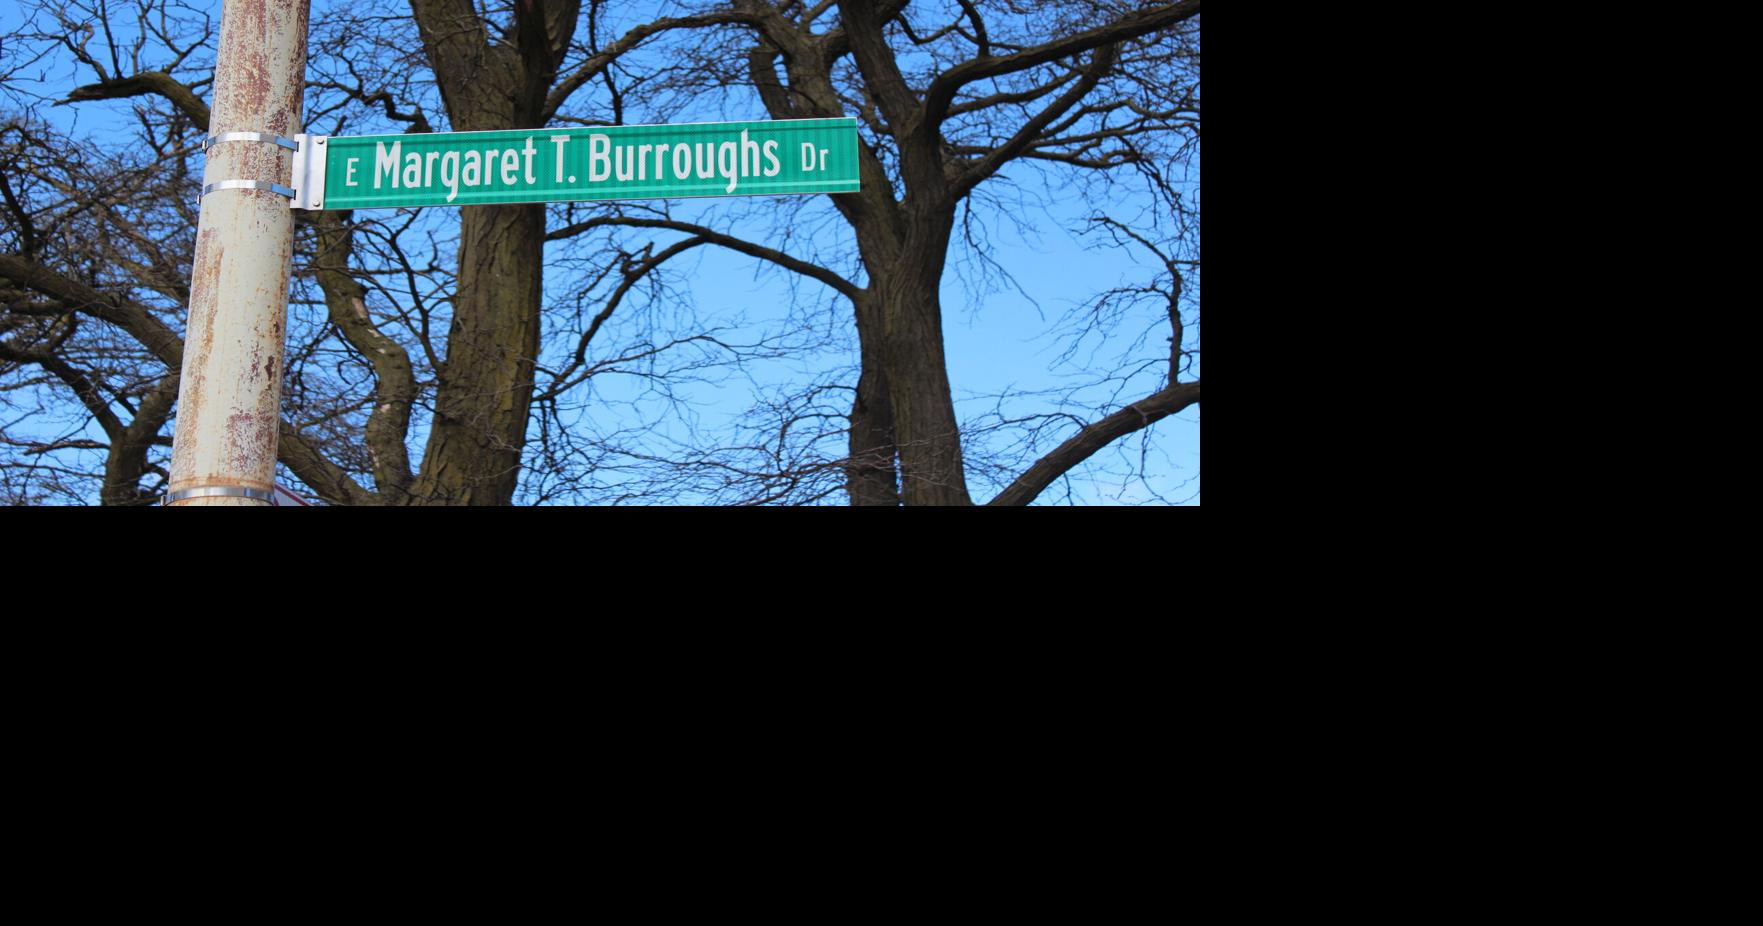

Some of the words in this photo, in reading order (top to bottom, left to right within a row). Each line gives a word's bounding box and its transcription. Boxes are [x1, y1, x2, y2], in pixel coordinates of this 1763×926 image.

[345, 157, 359, 186] E
[373, 137, 537, 202] Margaret
[551, 134, 577, 183] T.
[588, 129, 780, 194] Burroughs
[801, 142, 829, 172] Dr
